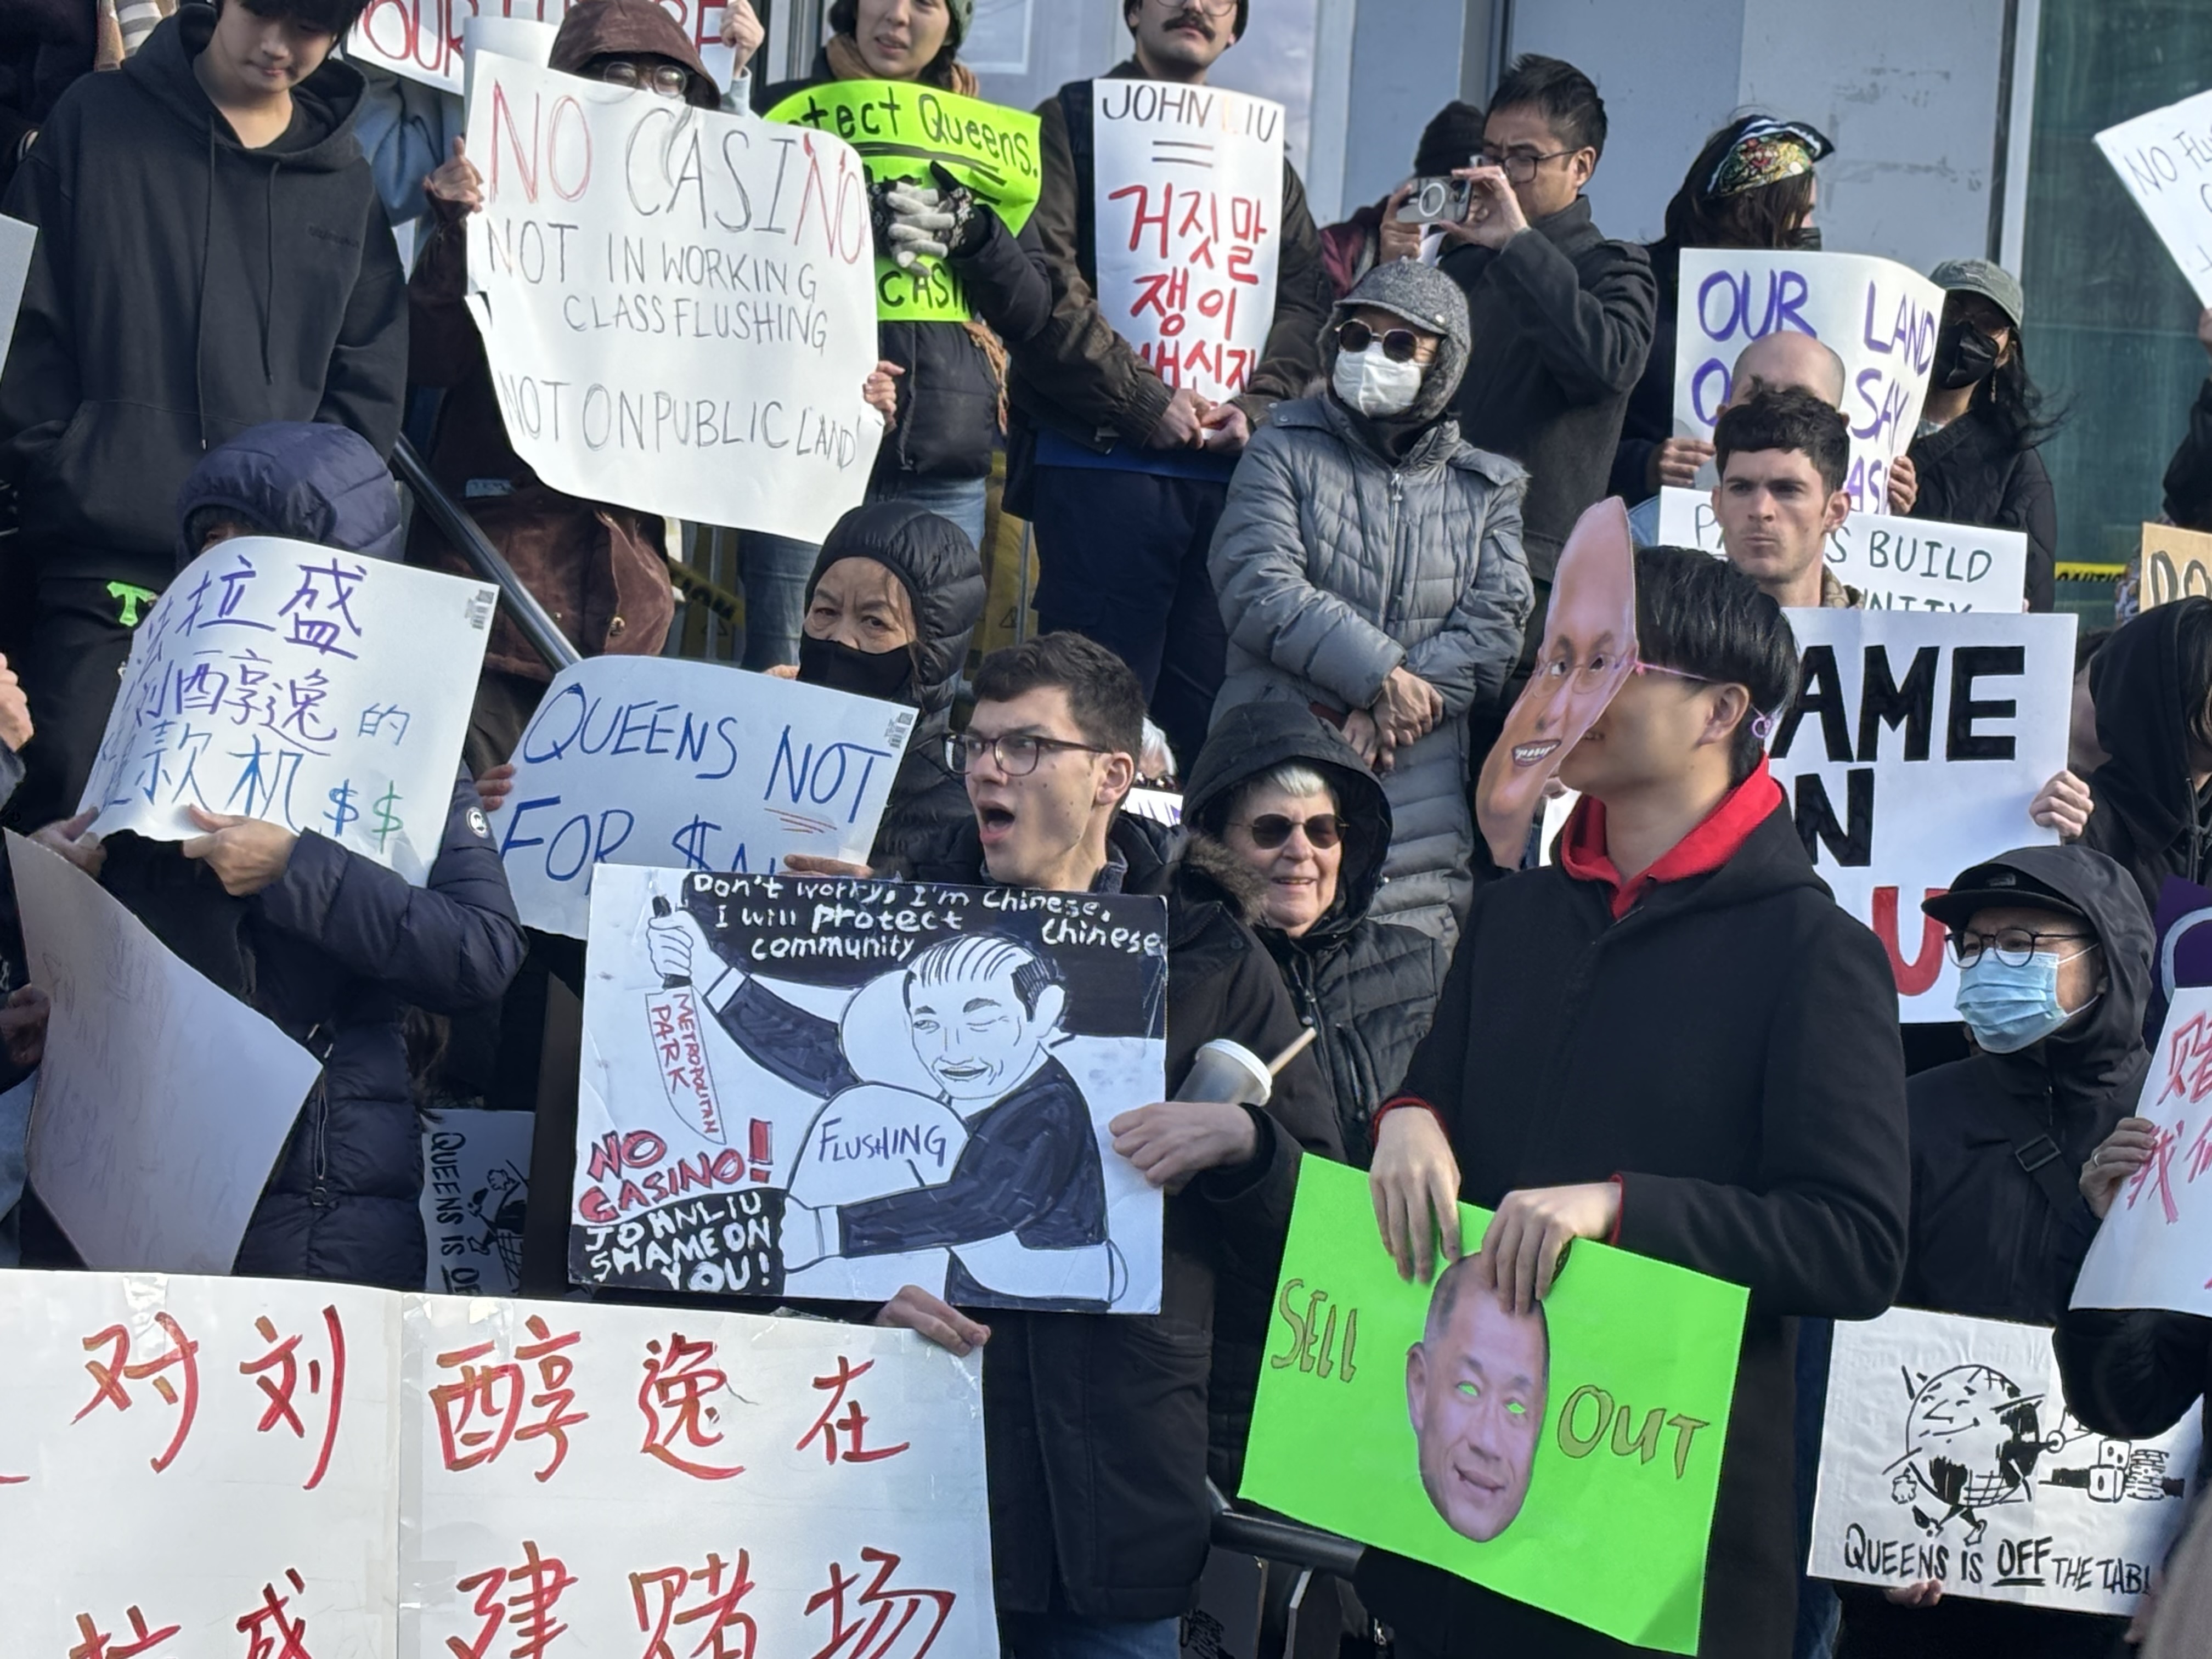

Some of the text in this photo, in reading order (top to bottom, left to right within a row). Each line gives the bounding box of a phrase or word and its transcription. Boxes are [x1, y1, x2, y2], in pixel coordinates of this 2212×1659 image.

[363, 0, 479, 77] OUR
[788, 86, 1039, 179] tect Queens.
[1102, 84, 1278, 143] JOHN LIU
[490, 79, 870, 264] NO CASINO
[2124, 147, 2177, 196] NO
[487, 218, 816, 305] NOT IN WORKING
[1108, 182, 1267, 286] 거짓말
[564, 294, 827, 354] CLASS FLUSHING
[1129, 267, 1237, 341] 쟁이
[1697, 270, 1934, 377] OUR LAND
[499, 370, 857, 472] NOT ON PUBLIC LAND
[1869, 531, 1993, 583] BUILD
[1769, 644, 2026, 763] AME
[523, 683, 893, 823] QUEENS NOT
[500, 795, 635, 895] FOR
[693, 873, 784, 900] Don't
[910, 884, 970, 907] I'm
[715, 905, 729, 928] I
[742, 908, 797, 928] will
[751, 934, 915, 962] community
[651, 1004, 691, 1095] PARK
[430, 1132, 466, 1225] QUEENS
[586, 1129, 668, 1183] NO
[819, 1118, 947, 1167] FLUSHING
[441, 1235, 465, 1256] IS
[590, 1216, 771, 1283] SHAME ON
[661, 1251, 770, 1293] YOU!
[0, 1304, 911, 1490] 对刘醇逸在
[1843, 1522, 2151, 1596] QUEENS IS OFF THE TABL
